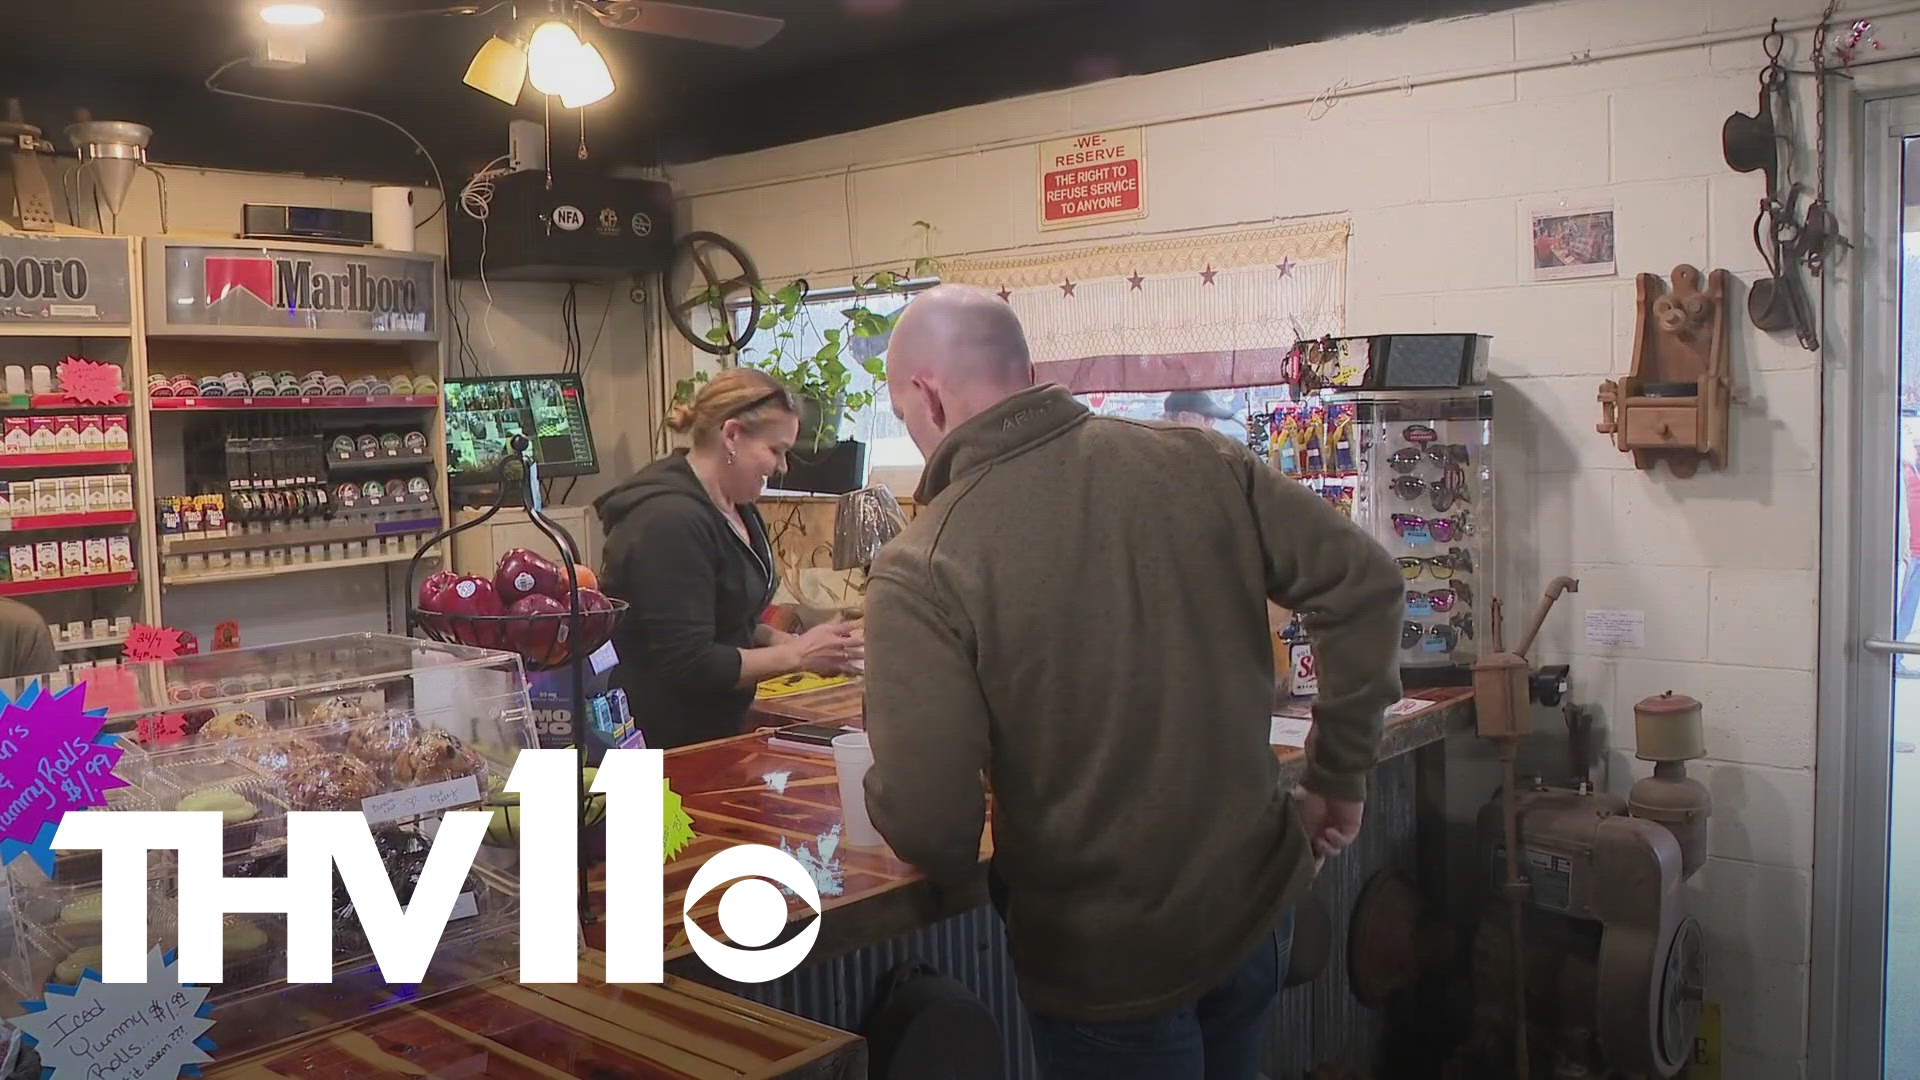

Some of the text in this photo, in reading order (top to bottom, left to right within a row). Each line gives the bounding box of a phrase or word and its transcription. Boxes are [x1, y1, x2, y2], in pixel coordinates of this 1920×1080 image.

[1055, 145, 1125, 168] RESERVE
[1047, 178, 1136, 203] REFUSE SERVICE
[1055, 165, 1127, 187] THE RIGHT TO
[557, 209, 580, 226] NFA
[1060, 195, 1122, 215] TO ANYONE
[276, 259, 417, 314] Marlboro
[137, 631, 162, 649] 24/7
[0, 724, 30, 760] n's
[37, 736, 90, 786] Rolls
[61, 753, 112, 803] $1.99
[47, 998, 106, 1048] Iced
[69, 991, 191, 1060] Yummy $1.99
